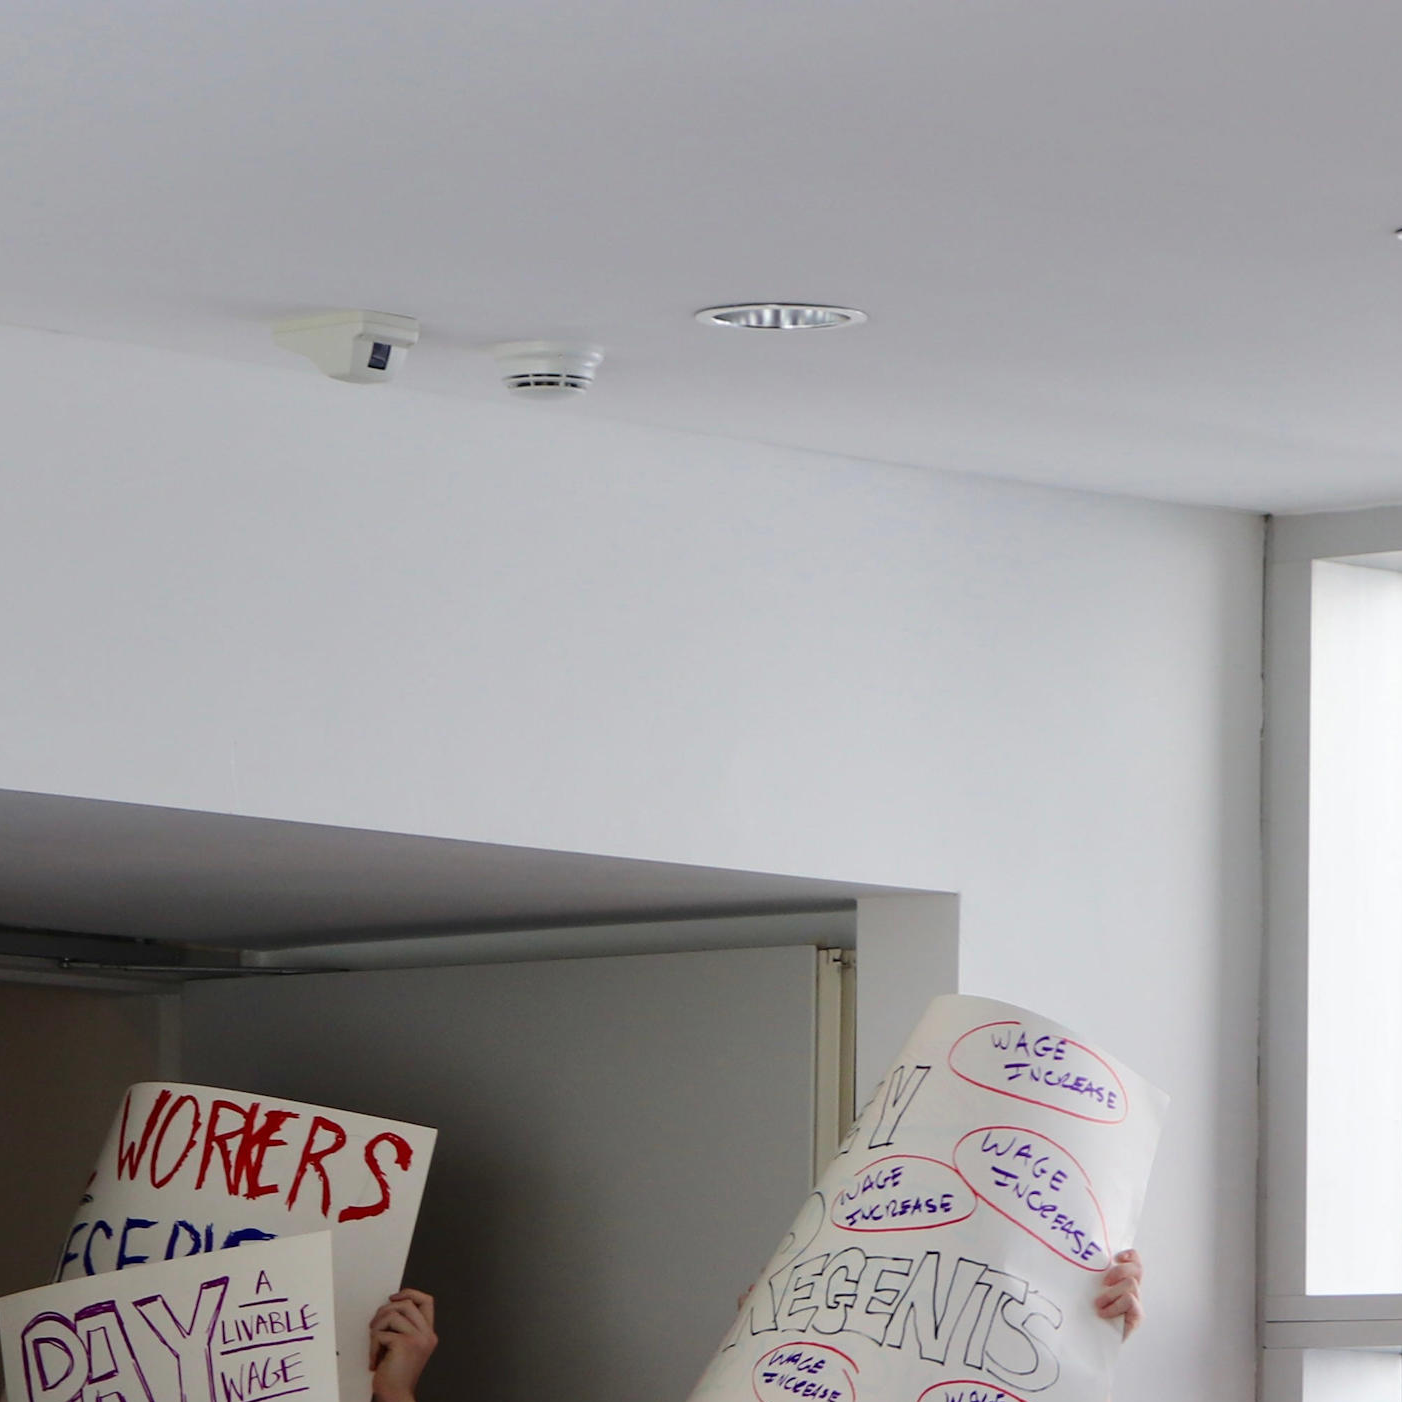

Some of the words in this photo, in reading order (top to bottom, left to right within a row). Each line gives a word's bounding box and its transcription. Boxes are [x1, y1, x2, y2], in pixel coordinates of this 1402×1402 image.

[991, 1030, 1067, 1060] WAGE
[1004, 1062, 1117, 1110] INCREASE
[118, 1089, 415, 1223] WORKERS
[980, 1131, 1068, 1192] WAGE
[845, 1194, 953, 1227] INCREASE
[991, 1166, 1101, 1263] INCREASE
[253, 1271, 273, 1295] A
[221, 1302, 320, 1349] LIVABLE
[222, 1355, 306, 1402] WAGE
[769, 1350, 825, 1375] WAGE
